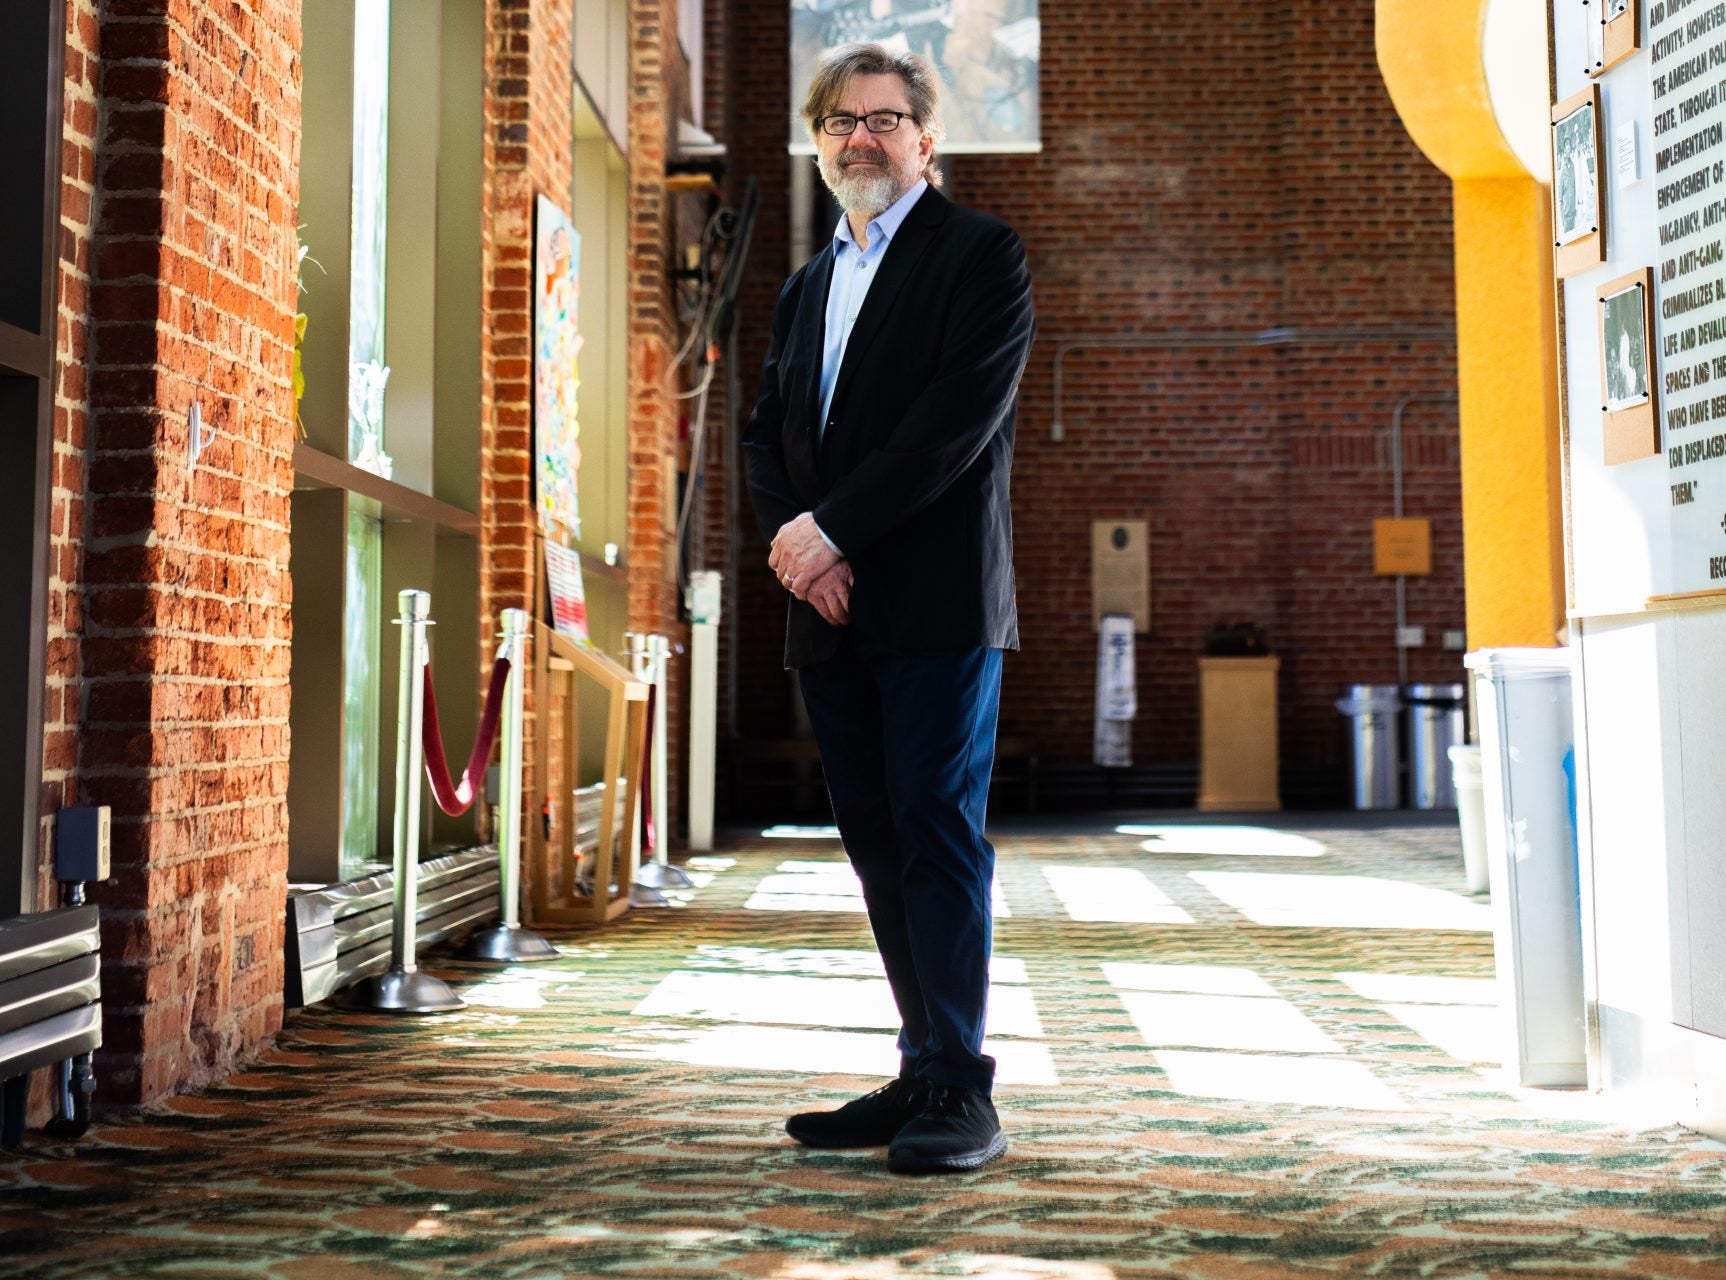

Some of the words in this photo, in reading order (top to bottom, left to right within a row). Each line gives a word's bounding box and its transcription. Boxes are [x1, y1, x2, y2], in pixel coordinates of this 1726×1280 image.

[1650, 2, 1664, 29] AND
[1652, 76, 1666, 101] THE
[1668, 51, 1707, 94] AMERICAN
[1709, 43, 1726, 70] POLI
[1654, 107, 1678, 137] STATE,
[1678, 84, 1718, 124] THROUGH
[1656, 121, 1722, 174] IMPLEMENTATION
[1658, 166, 1710, 210] ENFORCEMENT
[1713, 160, 1724, 184] OF
[1658, 210, 1700, 246] VAGRANCY,
[1662, 258, 1676, 284] AND
[1679, 239, 1724, 277] ANTI-GANG
[1662, 282, 1714, 320] CRIMINALIZES
[1664, 332, 1678, 358] LIFE
[1680, 327, 1696, 353] AND
[1698, 318, 1726, 346] DEVALU
[1666, 366, 1691, 394] SPACES
[1694, 362, 1710, 386] AND
[1667, 405, 1687, 430] WHO
[1690, 400, 1709, 426] HAVE
[1712, 394, 1726, 420] BEE
[1670, 480, 1698, 506] THEM."
